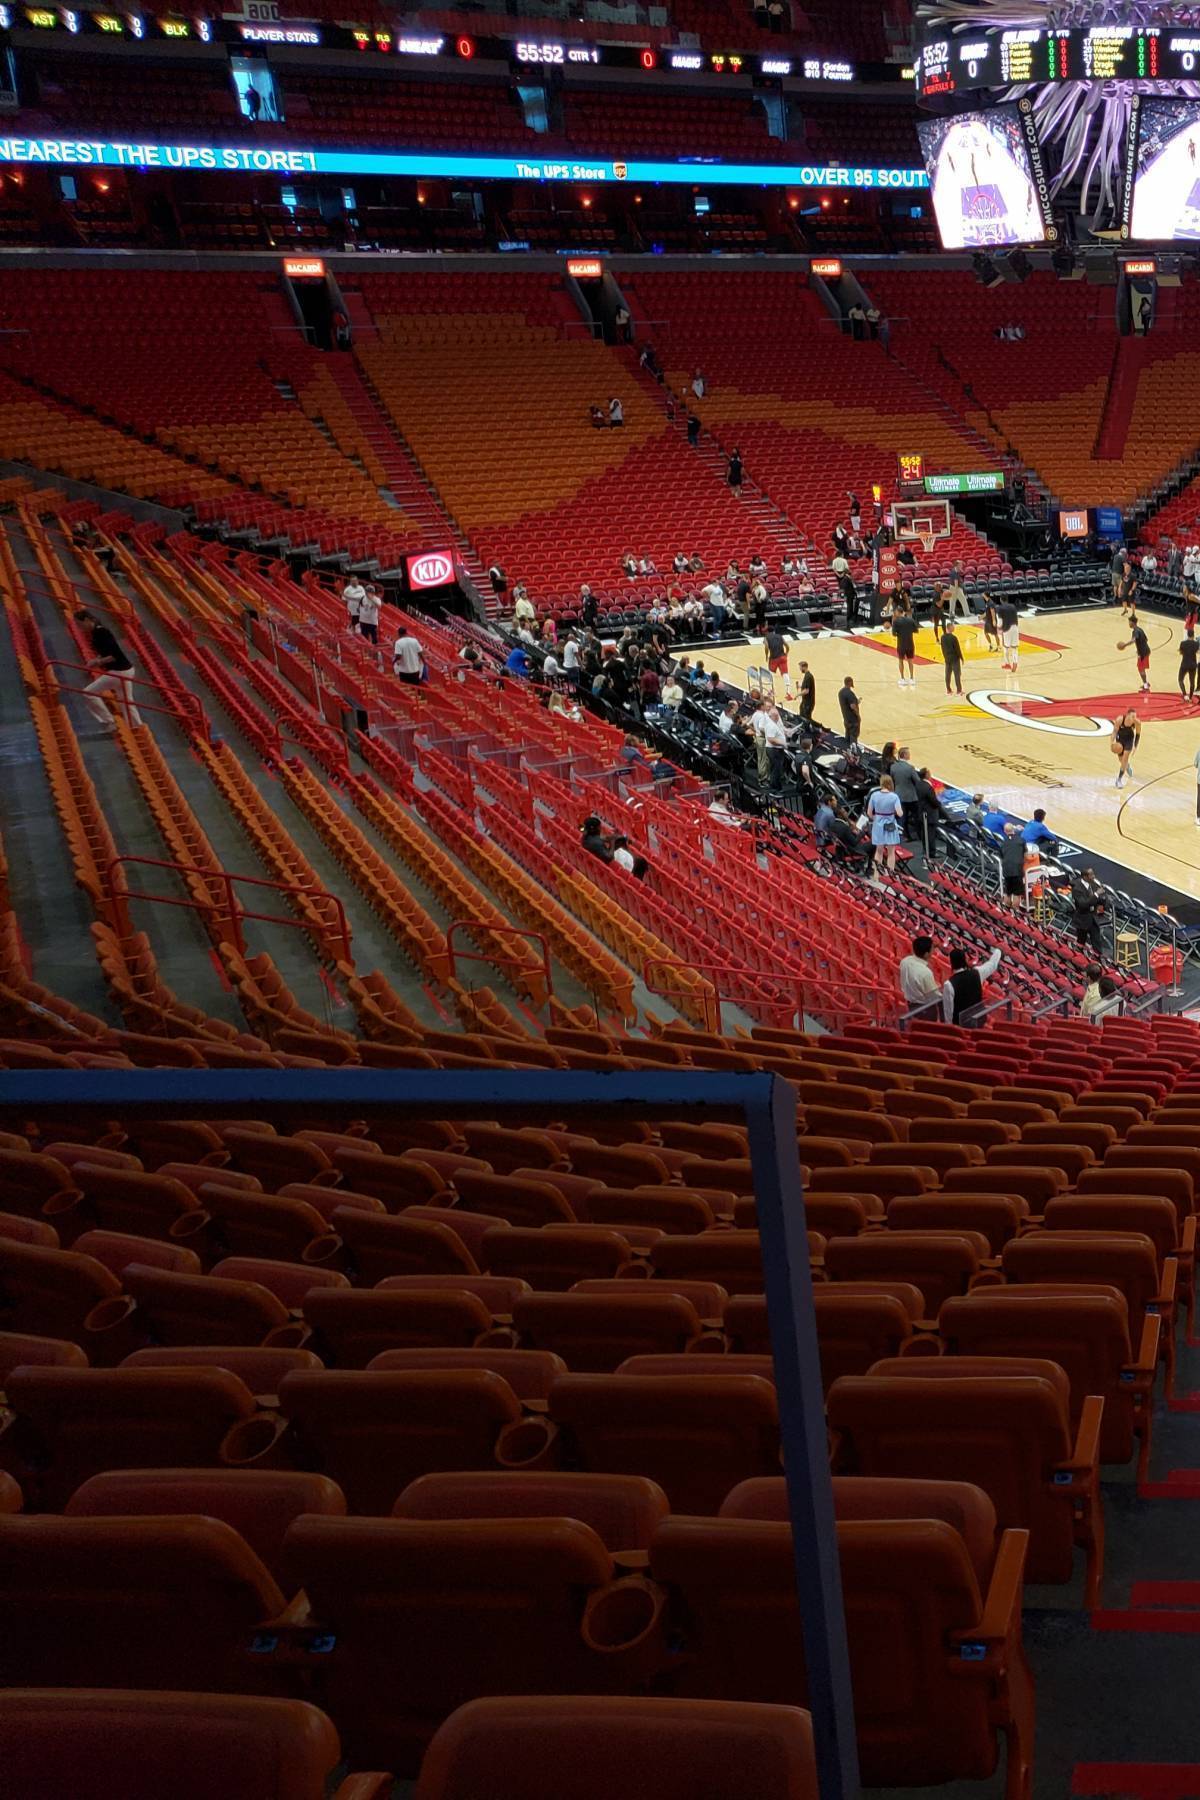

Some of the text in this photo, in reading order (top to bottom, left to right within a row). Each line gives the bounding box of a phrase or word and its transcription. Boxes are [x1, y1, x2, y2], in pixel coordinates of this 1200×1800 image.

[32, 13, 55, 27] AST
[101, 19, 122, 32] STL
[165, 24, 188, 36] BLK
[243, 28, 319, 44] PLAYER STATS
[353, 32, 369, 41] TOL
[376, 34, 390, 42] FLS
[460, 40, 470, 56] 0
[517, 43, 599, 63] 55:52 QTR 1
[923, 42, 949, 67] 55:52
[643, 52, 653, 67] 0
[671, 55, 701, 69] MAGIC
[712, 56, 724, 64] FLS
[729, 57, 741, 65] TOL
[823, 61, 850, 72] Gordon
[1182, 52, 1195, 70] 0
[762, 61, 790, 74] MAGIC
[968, 61, 977, 78] 0
[0, 140, 106, 163] NEAREST
[113, 143, 161, 166] THE
[166, 146, 216, 168] UPS
[516, 164, 605, 180] The UPS Store
[1024, 114, 1054, 225] MICCOSUKEE.COM
[1122, 111, 1138, 223] MICCOSUKEE.COM
[801, 168, 849, 186] OVER
[854, 169, 873, 185] 95
[901, 456, 921, 467] 55:52
[903, 466, 920, 479] 24
[929, 477, 960, 487] Ultimate
[966, 475, 997, 485] Ultimate
[418, 560, 446, 580] KIA
